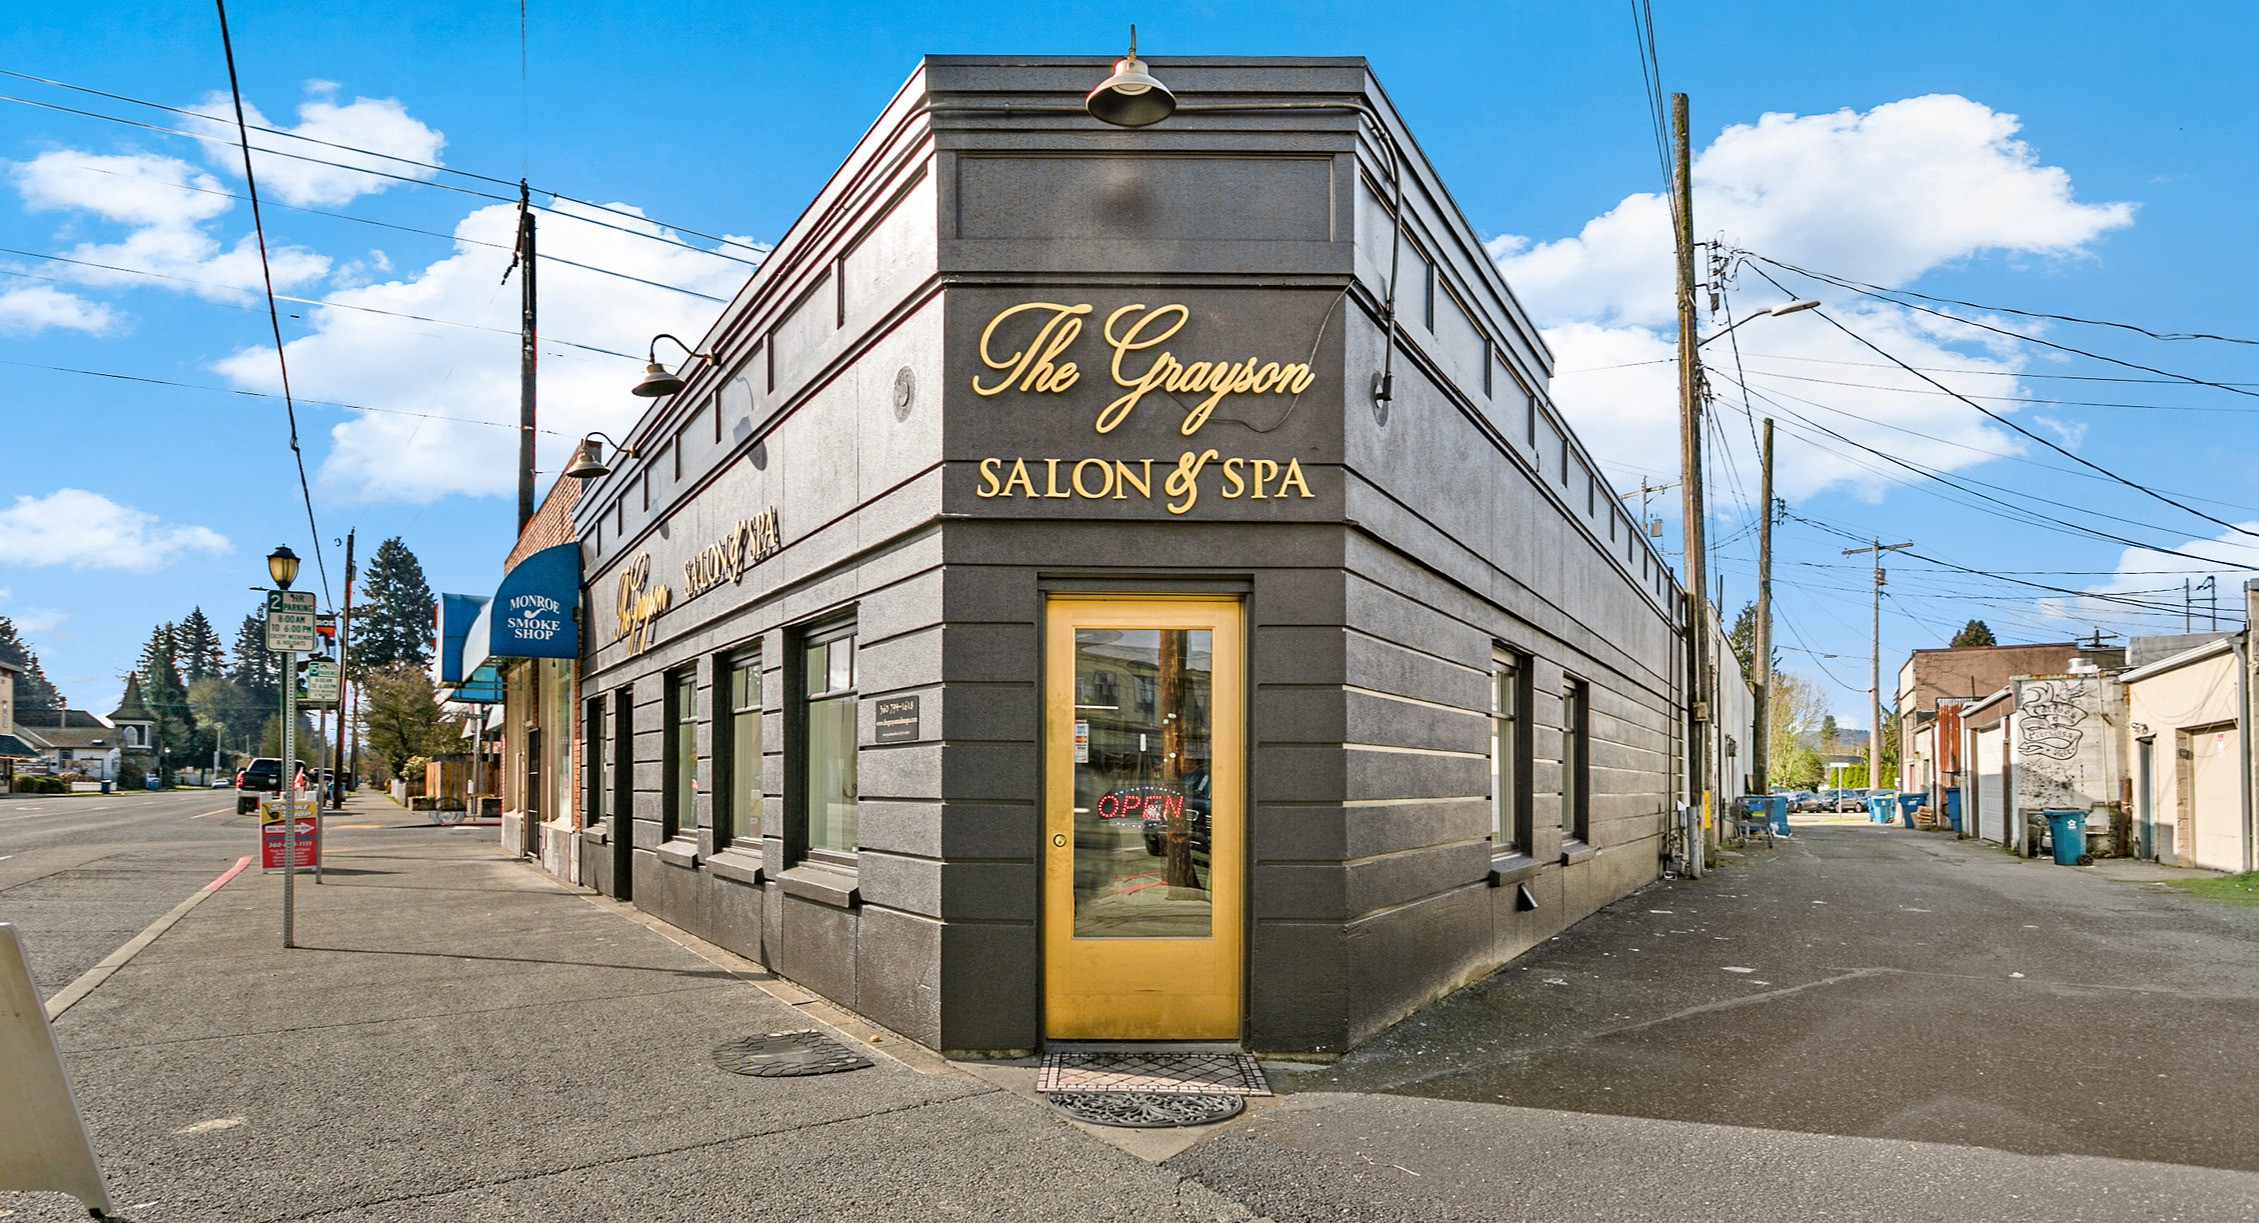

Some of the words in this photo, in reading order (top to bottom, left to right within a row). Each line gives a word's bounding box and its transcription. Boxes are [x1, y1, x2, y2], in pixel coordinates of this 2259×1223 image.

[972, 302, 1093, 396] The
[1096, 303, 1315, 435] Grayson
[977, 457, 1154, 500] SALON
[1164, 449, 1218, 514] &
[1221, 457, 1315, 499] SPA
[684, 535, 730, 596] SALON
[749, 505, 777, 560] SPA
[270, 594, 281, 610] 2
[284, 603, 313, 612] PARKING
[510, 595, 560, 614] MONROE
[271, 624, 280, 632] TO
[508, 617, 561, 630] SMOKE
[514, 628, 554, 640] SHOP
[1097, 795, 1184, 818] OPEN
